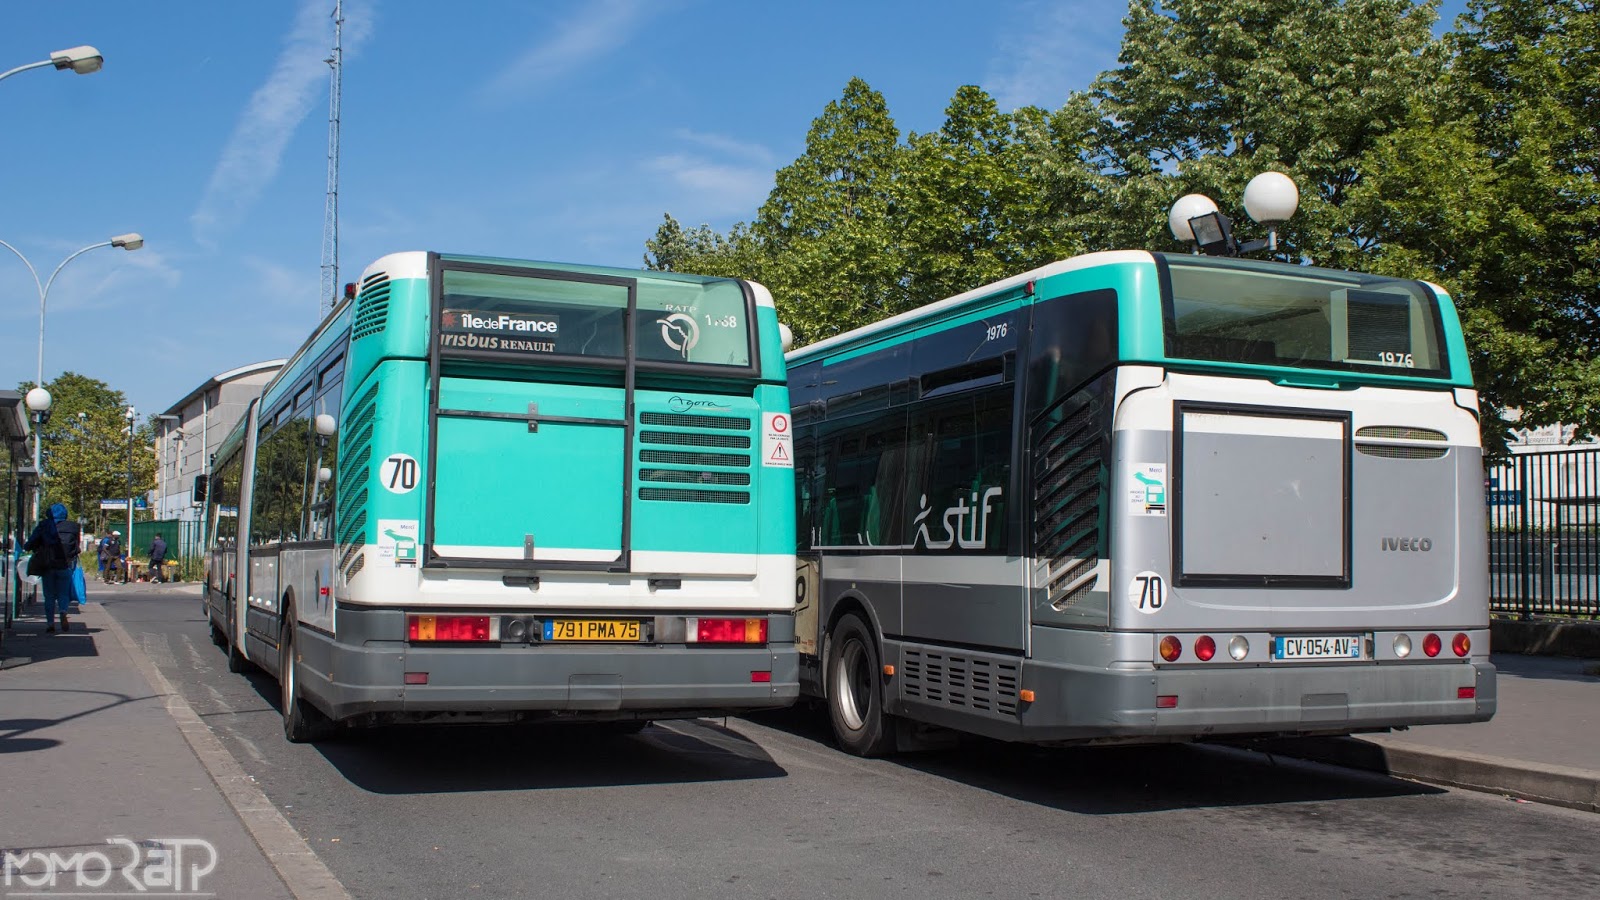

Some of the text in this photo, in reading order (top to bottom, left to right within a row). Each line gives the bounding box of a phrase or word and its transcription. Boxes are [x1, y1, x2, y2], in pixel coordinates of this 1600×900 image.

[665, 304, 697, 312] RATP
[986, 322, 1008, 341] 1976
[500, 339, 556, 352] RENAULT
[1378, 351, 1415, 368] 1976
[668, 396, 731, 413] Agora
[388, 458, 416, 490] 70
[1381, 537, 1432, 552] IVECO
[1135, 576, 1162, 609] 70
[556, 622, 583, 638] 791
[588, 622, 616, 638] PMA
[620, 622, 637, 638] 75
